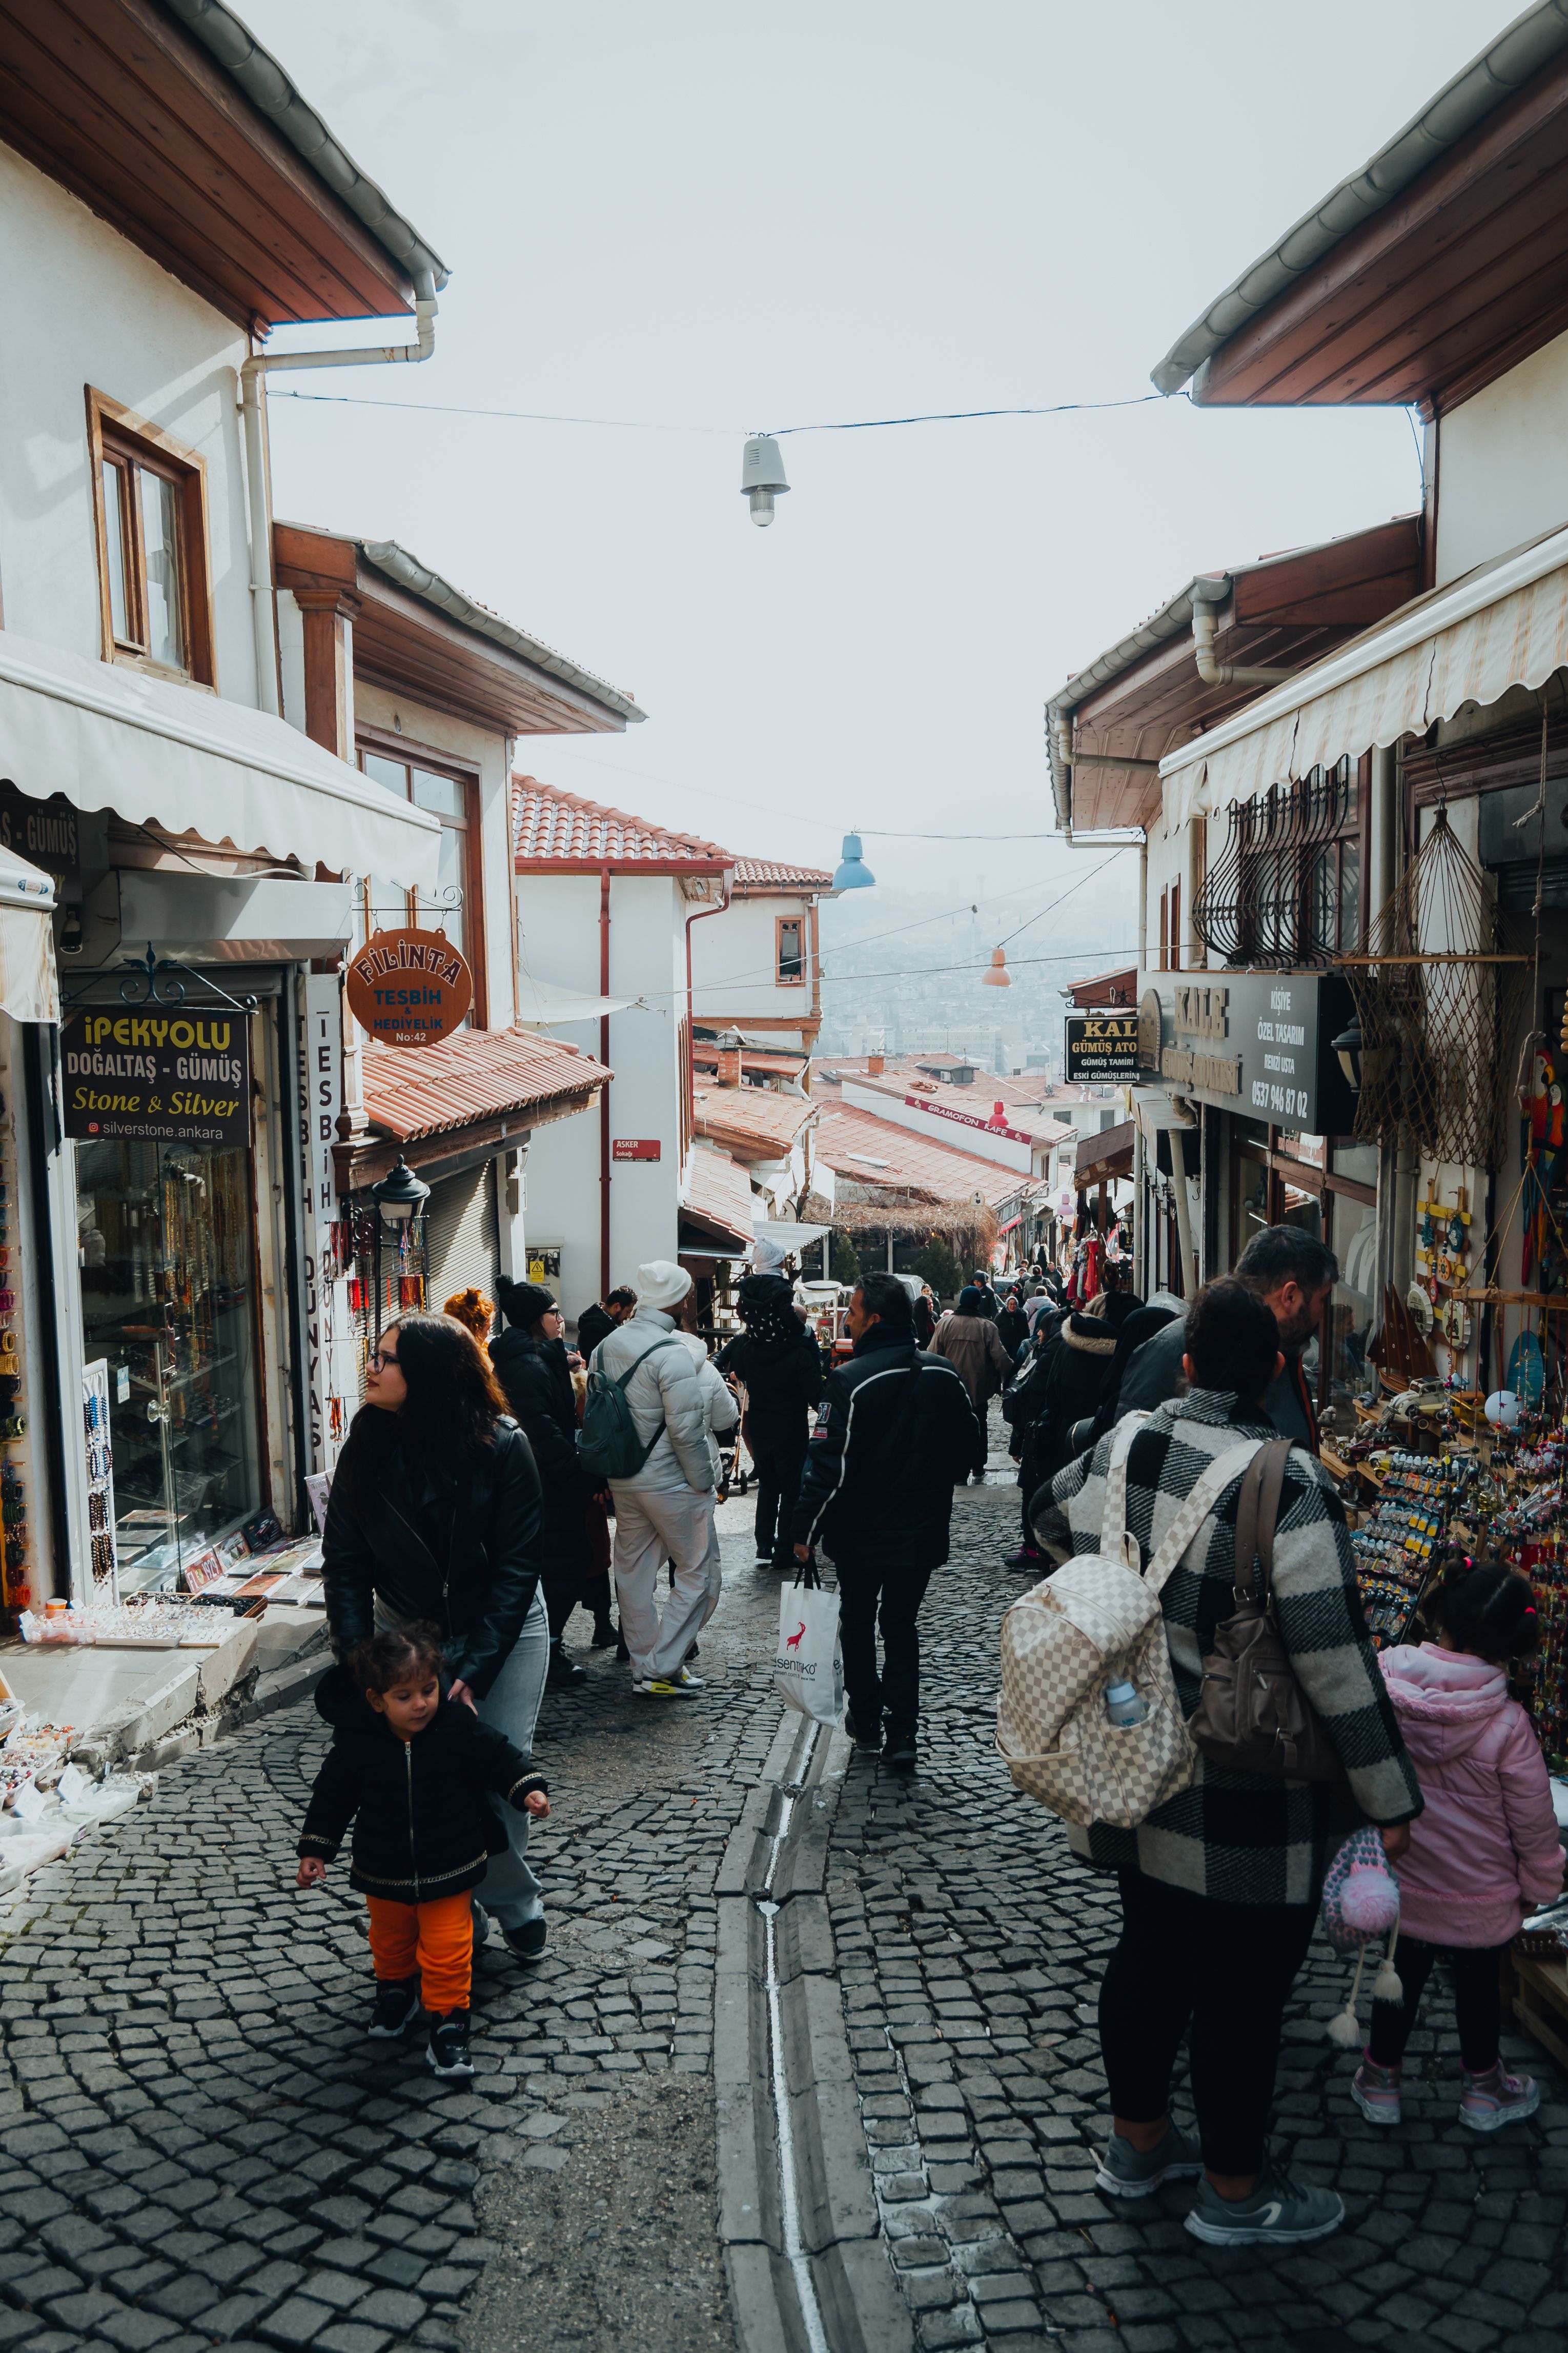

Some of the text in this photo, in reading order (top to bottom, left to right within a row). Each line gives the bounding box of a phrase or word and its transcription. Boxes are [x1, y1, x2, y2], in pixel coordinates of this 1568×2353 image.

[27, 808, 76, 864] GÜMÜŞ
[353, 939, 462, 988] FİLİNTA
[374, 986, 441, 1004] TESBİH
[1271, 987, 1291, 1016] KİŞİYE
[374, 1016, 443, 1030] HEDİYELİK
[1174, 987, 1228, 1037] KALE
[396, 1033, 426, 1041] No:42
[1258, 1016, 1305, 1045] ÖZEL TASARIM
[1072, 1040, 1112, 1055] GÜMÜŞ
[1081, 1057, 1133, 1067] GÜMÜŞ TAMİRİ
[68, 1048, 156, 1083] DOĞALTAŞ
[177, 1052, 242, 1088] GÜMÜŞ
[1073, 1071, 1089, 1079] ESKİ
[1264, 1052, 1295, 1074] REMZİ USTA
[72, 1087, 239, 1116] Stone & Silver
[1252, 1080, 1308, 1118] 0537 946 87 02
[103, 1122, 223, 1139] silverstone.ankara
[927, 1104, 1008, 1136] GRAMOFON KAFE
